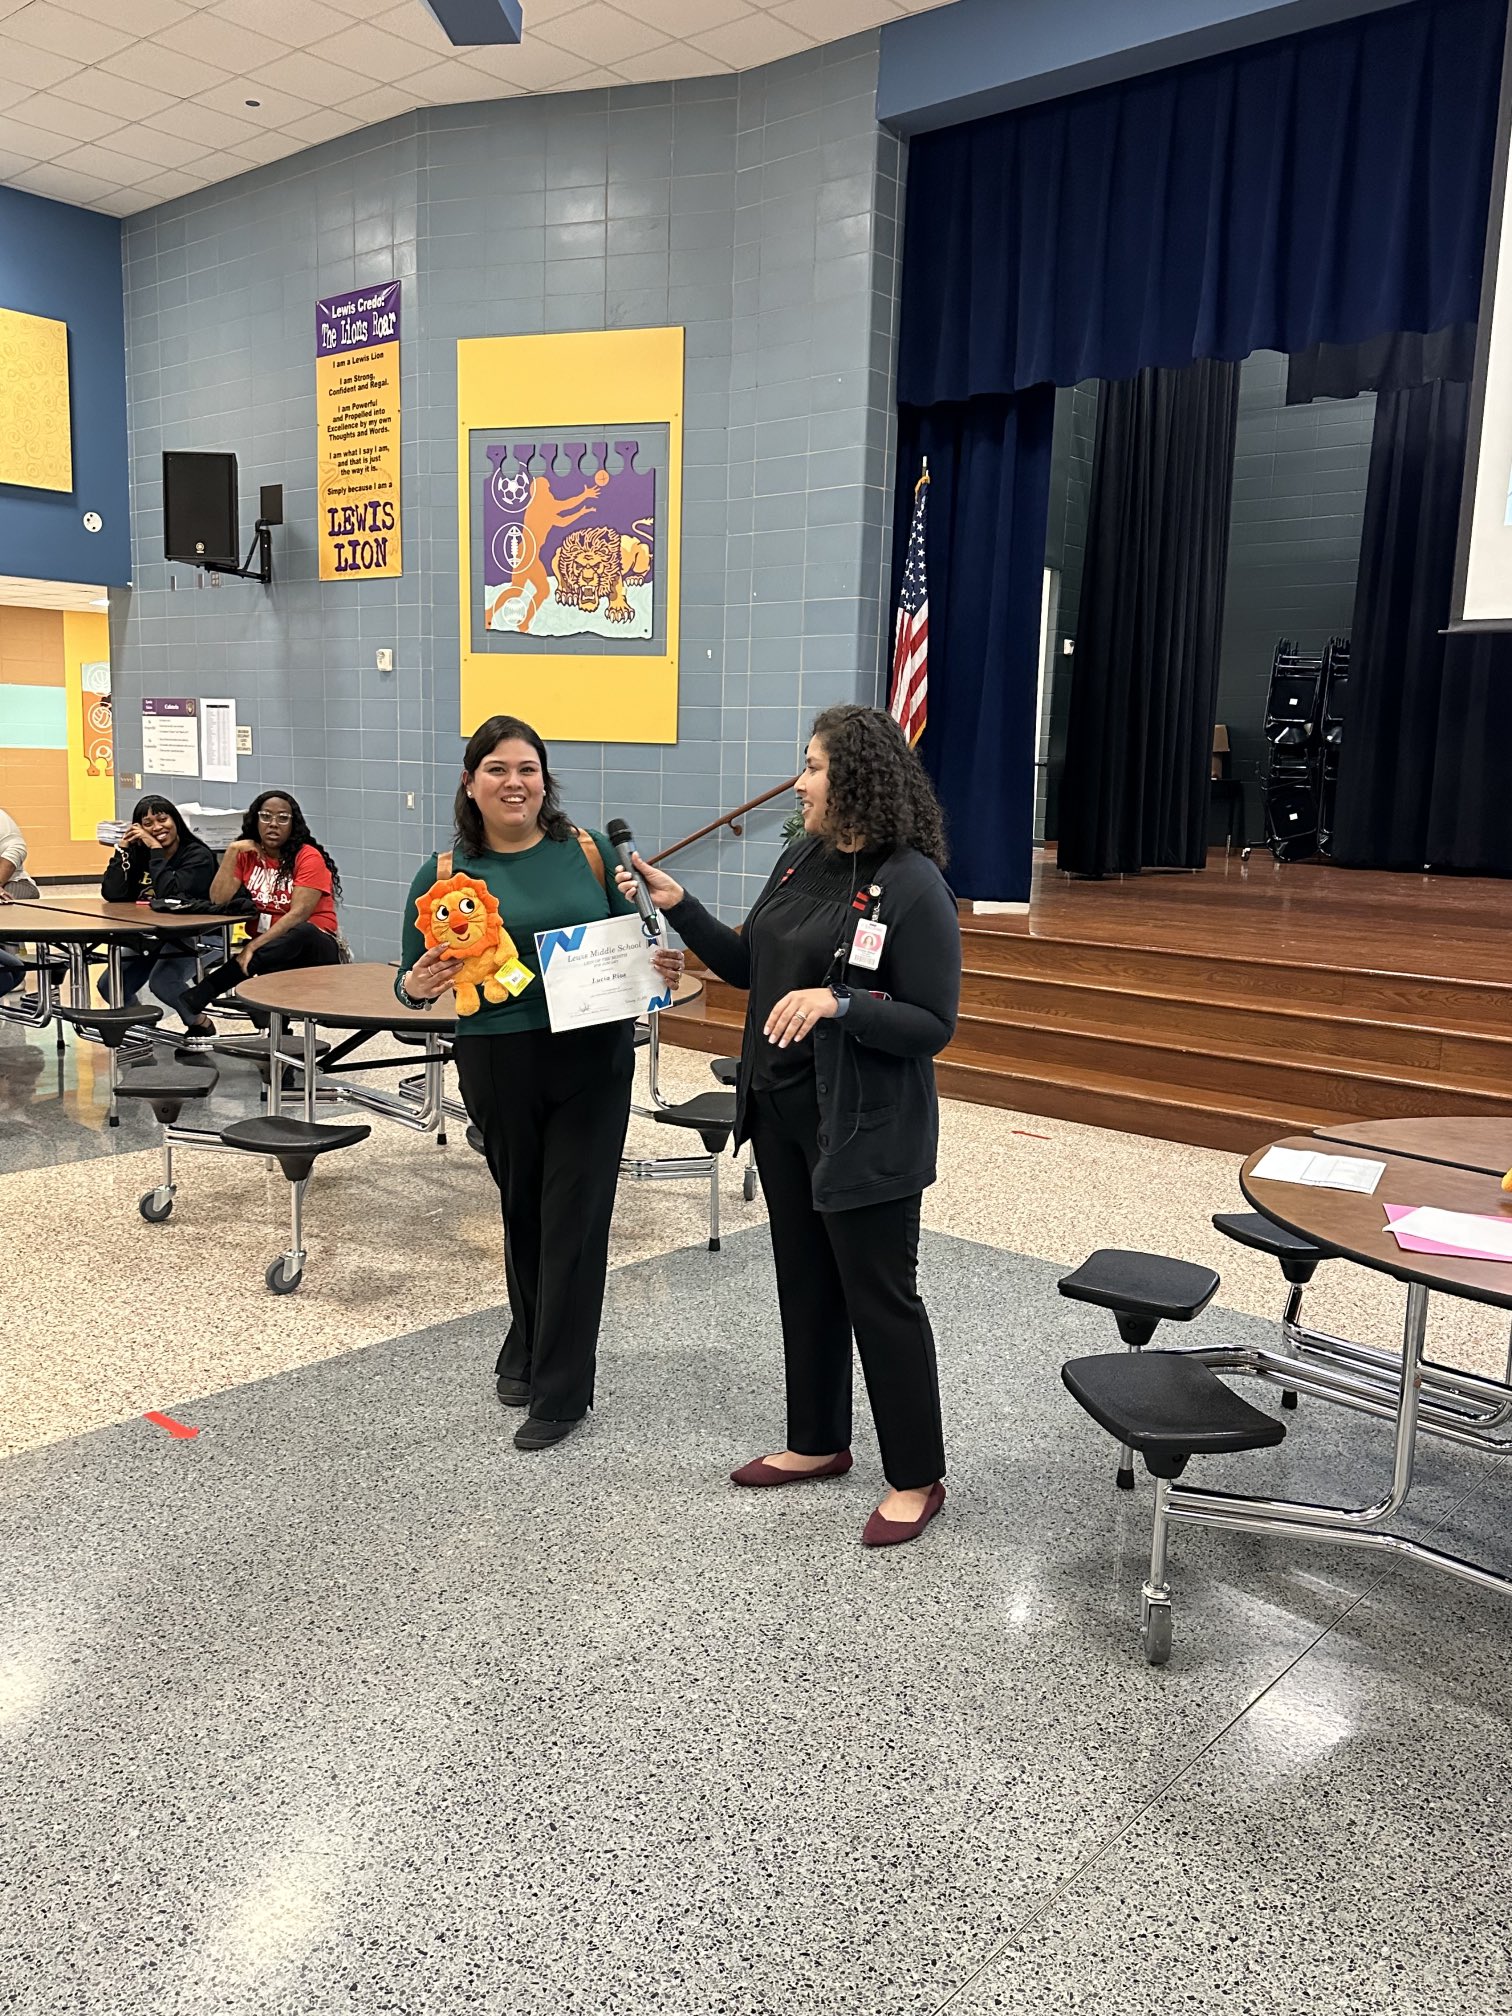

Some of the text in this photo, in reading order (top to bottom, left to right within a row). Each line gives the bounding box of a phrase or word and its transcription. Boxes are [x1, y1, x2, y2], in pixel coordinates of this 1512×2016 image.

[332, 295, 385, 318] Lewis Credo:
[321, 311, 396, 349] The Lions Roar
[332, 361, 336, 369] I
[336, 360, 346, 368] am
[352, 355, 370, 365] Lewis
[371, 352, 384, 361] Lion
[328, 385, 357, 397] Confident
[357, 382, 369, 391] and
[337, 405, 341, 413] I
[351, 399, 378, 410] Powerful
[332, 408, 386, 423] and Propelled into
[327, 416, 392, 433] Excellence by my own
[328, 431, 356, 442] Thoughts
[356, 429, 368, 438] and
[342, 449, 358, 458] what
[358, 447, 362, 455] I
[362, 447, 374, 456] say
[337, 454, 381, 468] and that is just
[340, 468, 351, 476] the
[351, 467, 364, 476] way
[364, 465, 370, 473] it
[327, 481, 393, 497] Simply because I am a
[327, 500, 395, 537] LEWIS
[333, 536, 389, 573] LION
[590, 947, 616, 958] Middle
[617, 940, 642, 952] School
